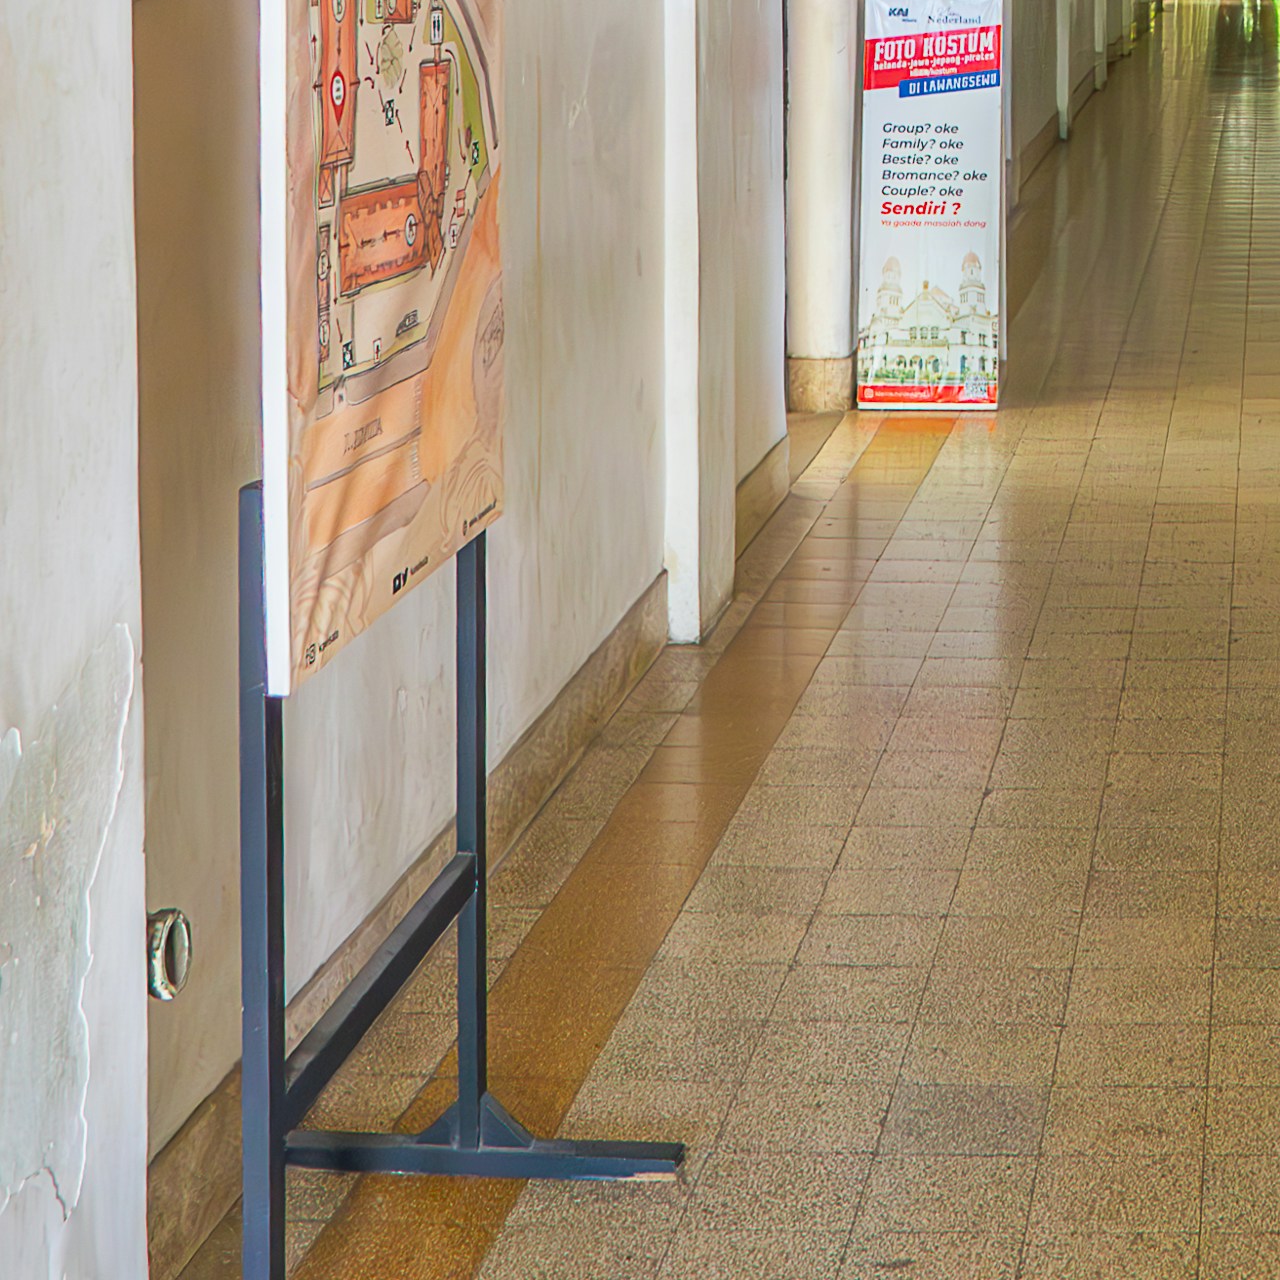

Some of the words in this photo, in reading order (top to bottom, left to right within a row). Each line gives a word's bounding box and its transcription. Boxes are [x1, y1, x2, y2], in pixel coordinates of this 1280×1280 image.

[888, 7, 909, 17] KAI
[927, 16, 981, 25] Nederland
[874, 39, 916, 61] FOTO
[922, 32, 995, 57] KOSTUM
[909, 82, 921, 95] DI
[923, 73, 997, 93] LAWANGSEWU
[882, 122, 931, 135] Group?
[934, 123, 959, 134] oke
[882, 138, 936, 151] Family?
[939, 139, 964, 149] oke
[882, 154, 931, 165] Bestie?
[934, 154, 959, 165] oke
[882, 169, 960, 181] Bromance?
[962, 170, 988, 181] oke
[881, 185, 936, 198] Couple?
[938, 186, 964, 197] oke
[880, 200, 947, 215] Sendiri
[963, 220, 987, 229] dong
